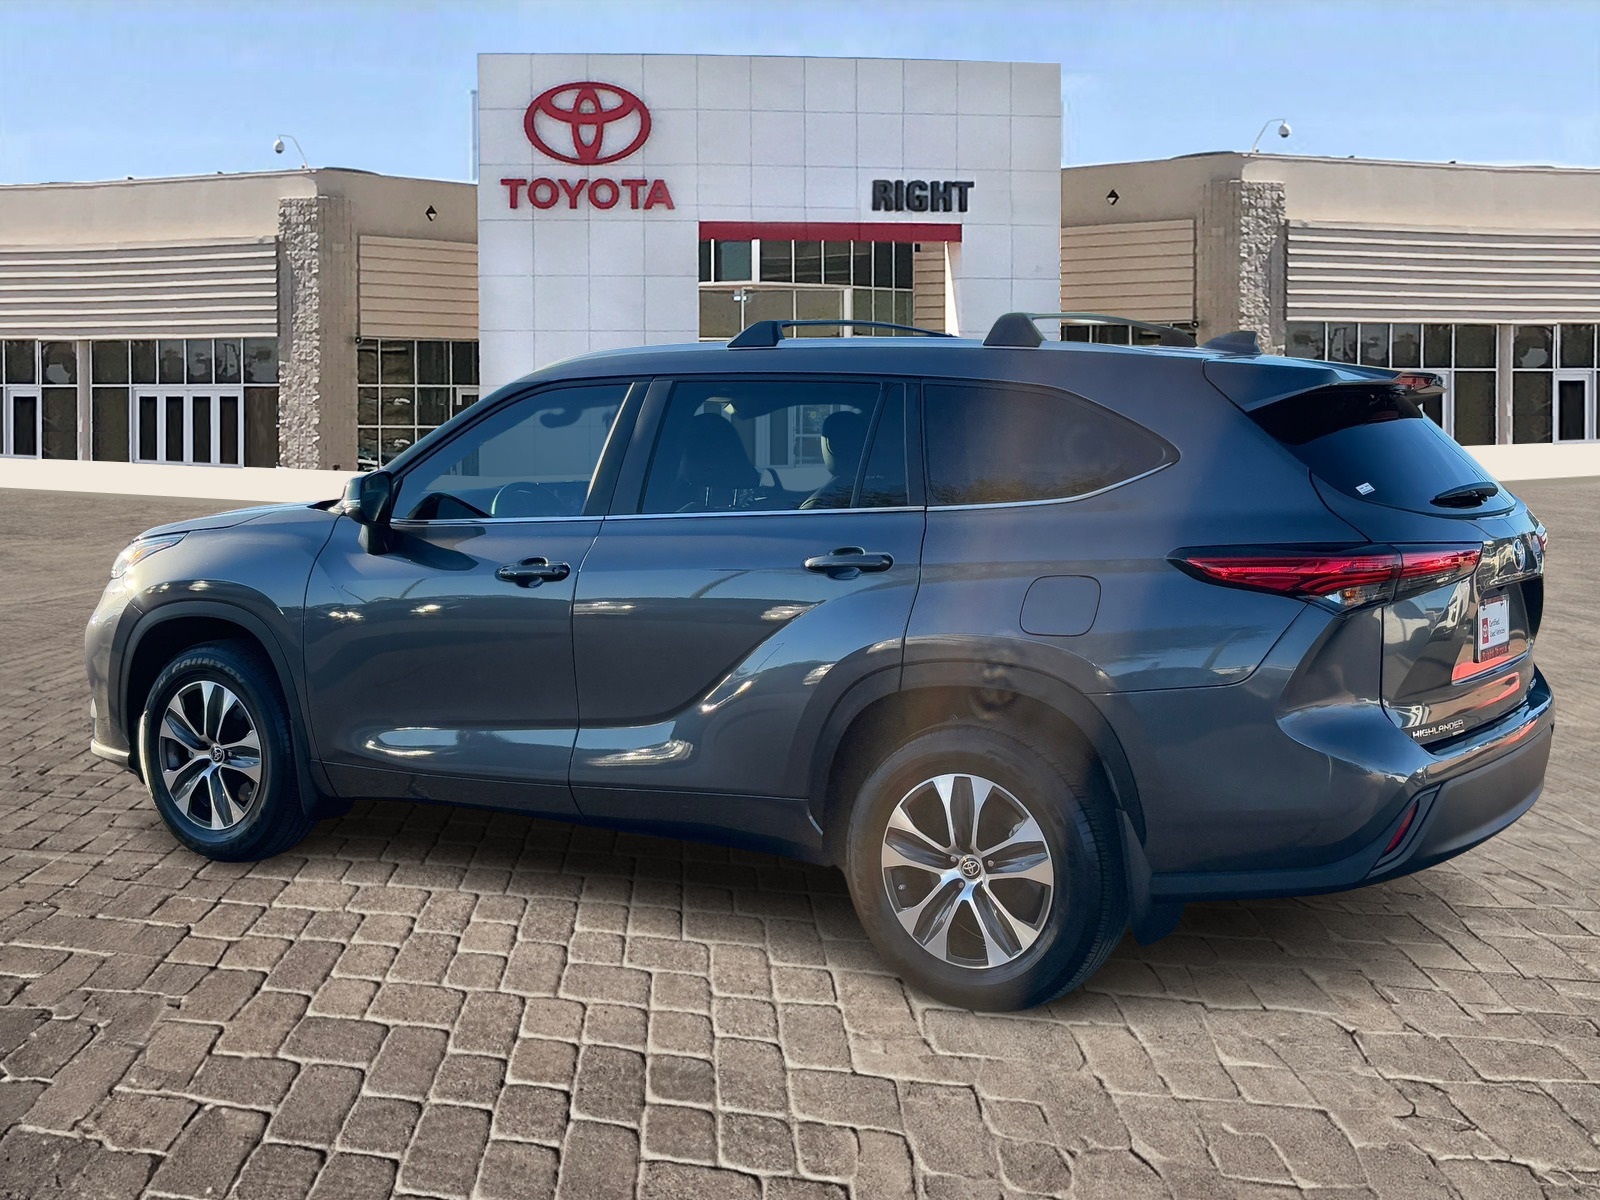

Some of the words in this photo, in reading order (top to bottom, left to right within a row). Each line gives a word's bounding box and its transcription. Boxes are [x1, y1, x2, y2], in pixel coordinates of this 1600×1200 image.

[500, 177, 675, 210] TOYOTA
[871, 179, 975, 213] RIGHT
[1412, 719, 1464, 739] HIGHLANDER
